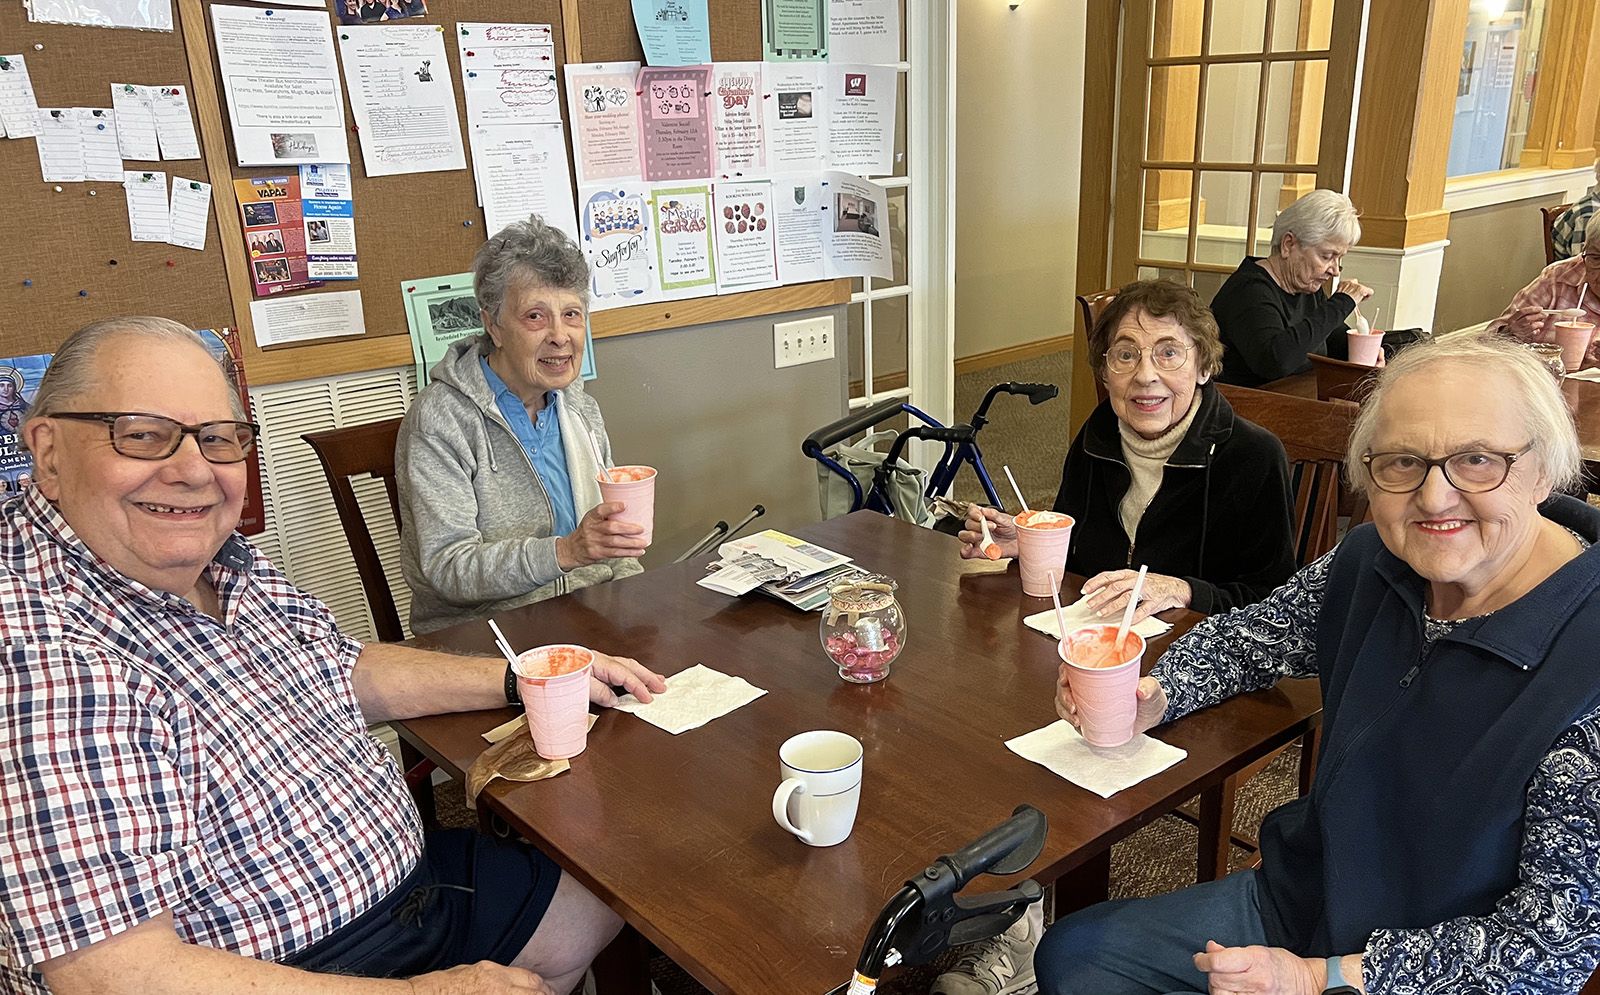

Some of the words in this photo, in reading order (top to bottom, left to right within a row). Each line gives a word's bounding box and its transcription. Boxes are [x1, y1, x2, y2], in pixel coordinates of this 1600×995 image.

[850, 78, 861, 88] W
[723, 95, 750, 109] Day
[257, 188, 287, 198] VAPAS
[668, 208, 700, 220] Mardi
[660, 217, 707, 234] GRAS
[0, 456, 26, 464] OMEN
